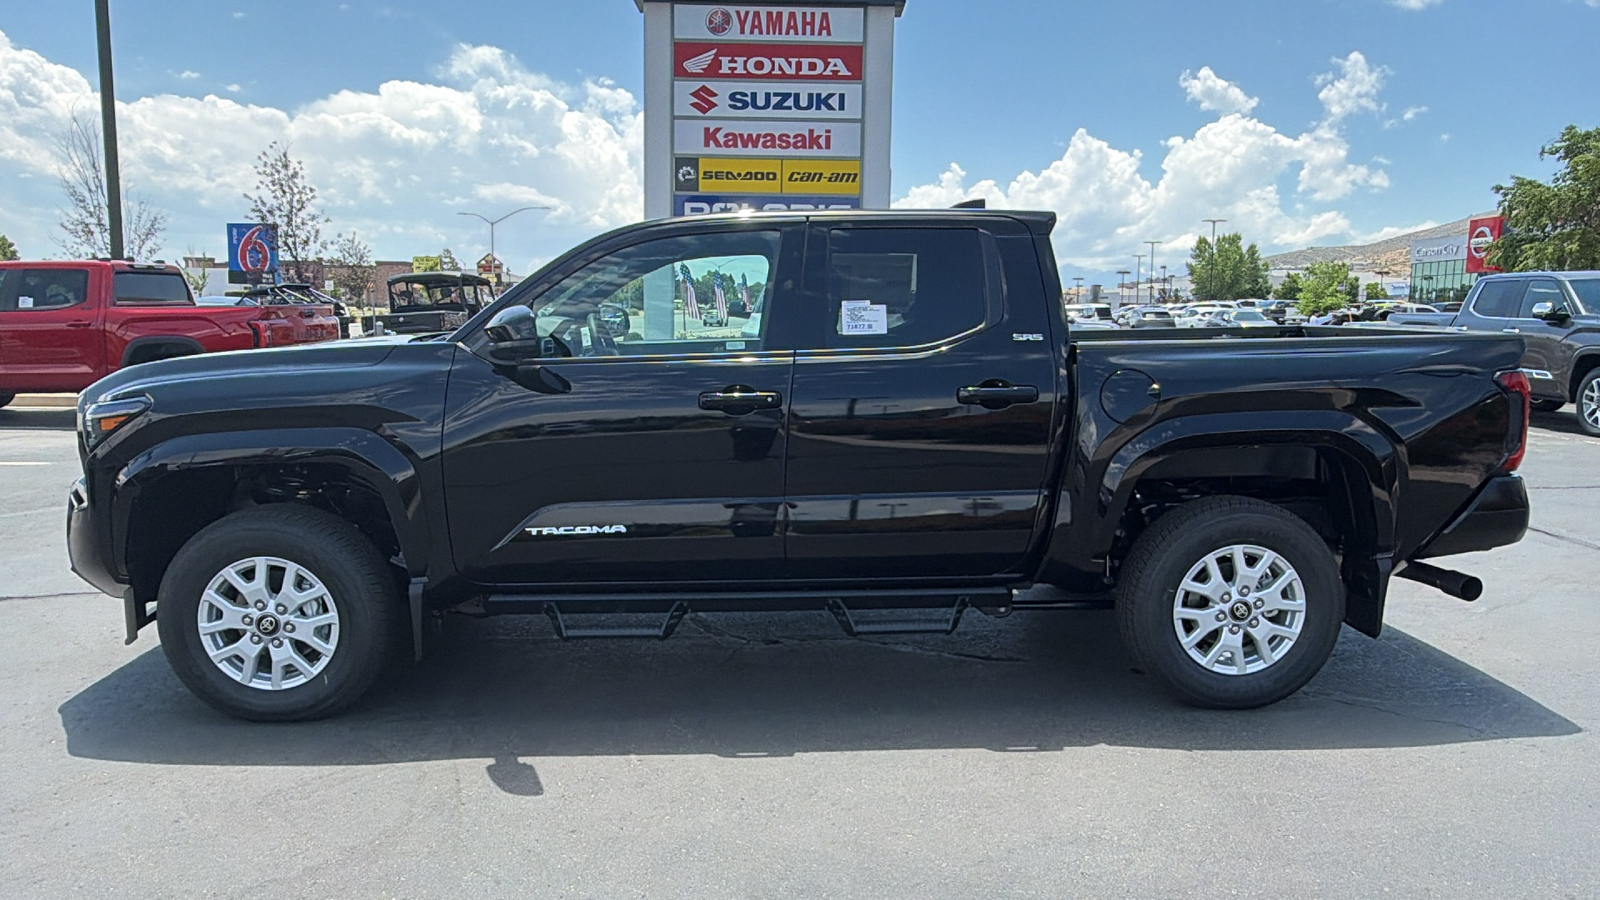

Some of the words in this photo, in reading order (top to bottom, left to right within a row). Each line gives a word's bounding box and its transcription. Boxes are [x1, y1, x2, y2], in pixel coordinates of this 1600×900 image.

[735, 10, 832, 36] YAMAHA
[718, 56, 852, 76] HONDA
[728, 91, 846, 112] SUZUKI
[703, 127, 832, 150] Kawasaki
[787, 171, 858, 183] can-am
[238, 225, 270, 271] 6
[1415, 246, 1442, 257] Carson
[1442, 244, 1459, 256] City
[524, 525, 627, 535] TACOMA
